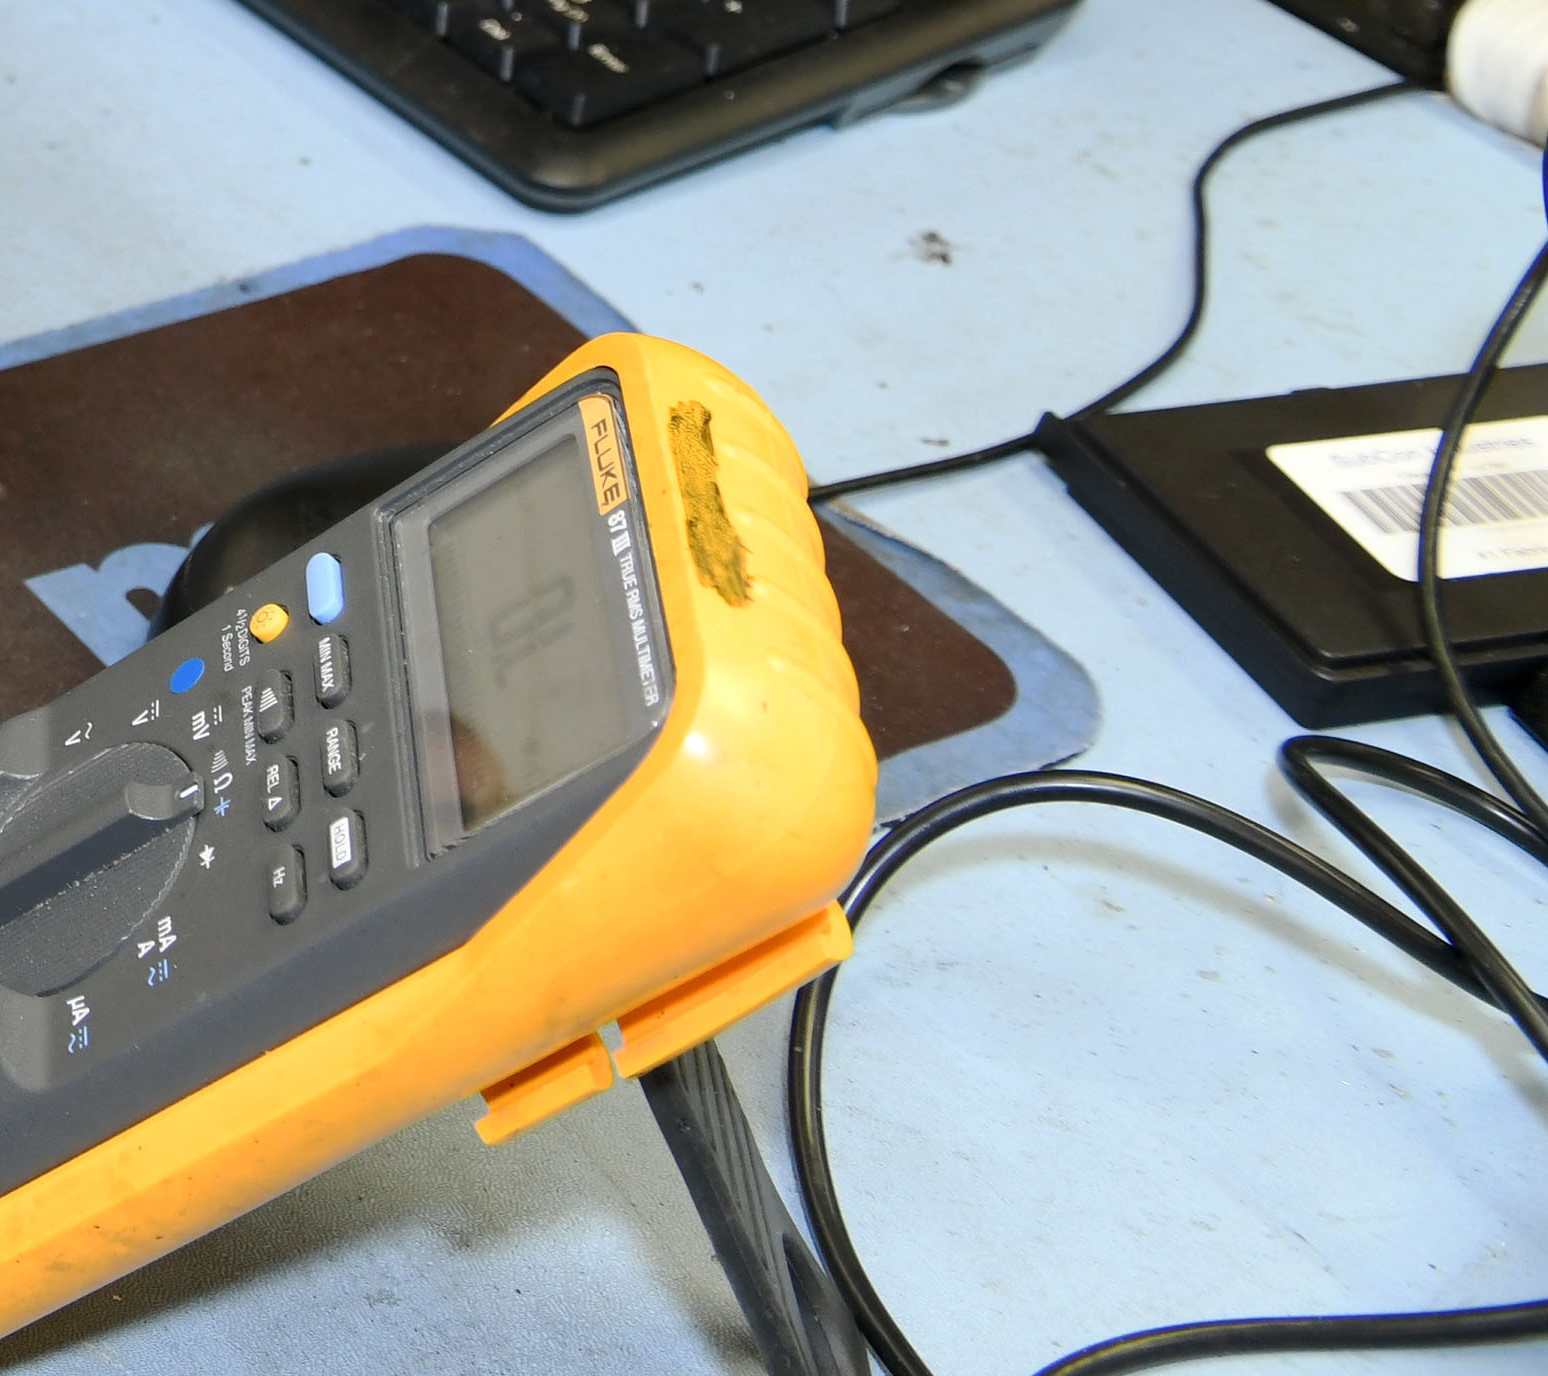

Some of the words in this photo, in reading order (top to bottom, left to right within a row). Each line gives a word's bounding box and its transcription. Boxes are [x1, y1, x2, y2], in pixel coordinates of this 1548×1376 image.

[591, 418, 621, 506] FLUKE
[607, 509, 627, 533] 87
[619, 552, 638, 590] TRUE
[626, 589, 644, 620] RMS
[221, 632, 235, 673] Second
[317, 636, 332, 664] MIN
[631, 619, 659, 707] MULTIMETER
[320, 661, 336, 693] MAX
[241, 685, 255, 714] PEAK
[192, 711, 211, 742] mV
[242, 711, 256, 740] MIN
[244, 738, 258, 767] MAX
[326, 726, 343, 776] RANGE
[266, 764, 280, 794] REL
[332, 824, 347, 863] HOLD
[273, 866, 287, 889] Hz
